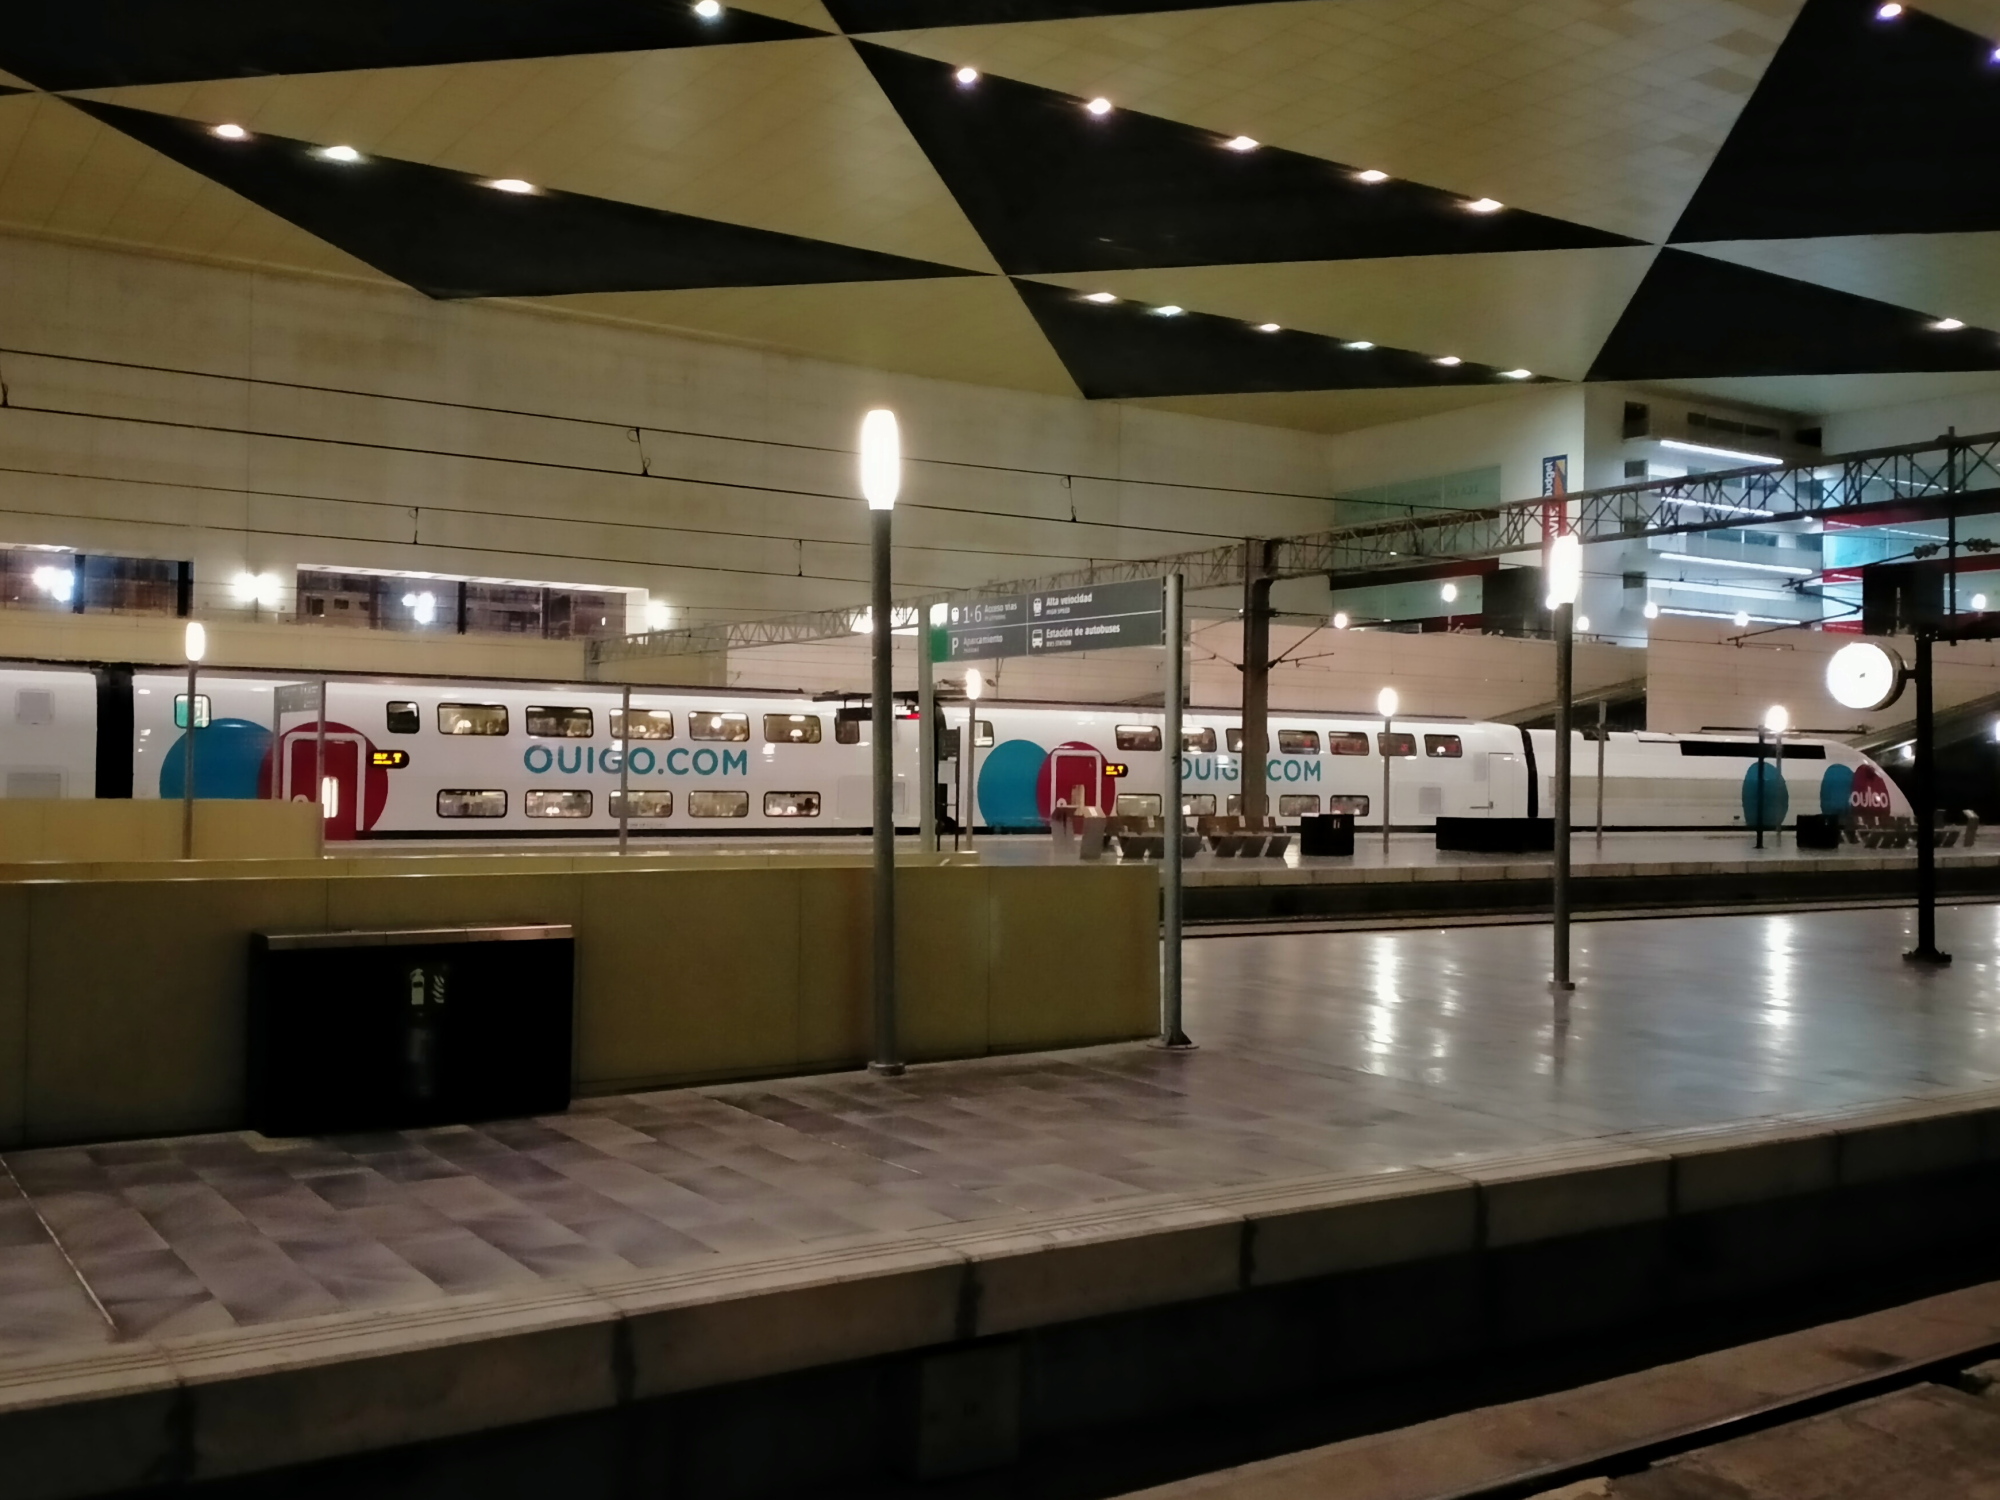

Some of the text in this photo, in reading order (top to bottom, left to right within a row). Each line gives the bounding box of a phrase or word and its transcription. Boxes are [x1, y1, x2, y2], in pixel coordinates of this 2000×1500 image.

[1046, 592, 1093, 606] Alta velocidad
[1046, 624, 1120, 638] Estación de autobuses
[524, 744, 747, 776] OUIGO.COM
[1182, 758, 1321, 782] OUIGCOM
